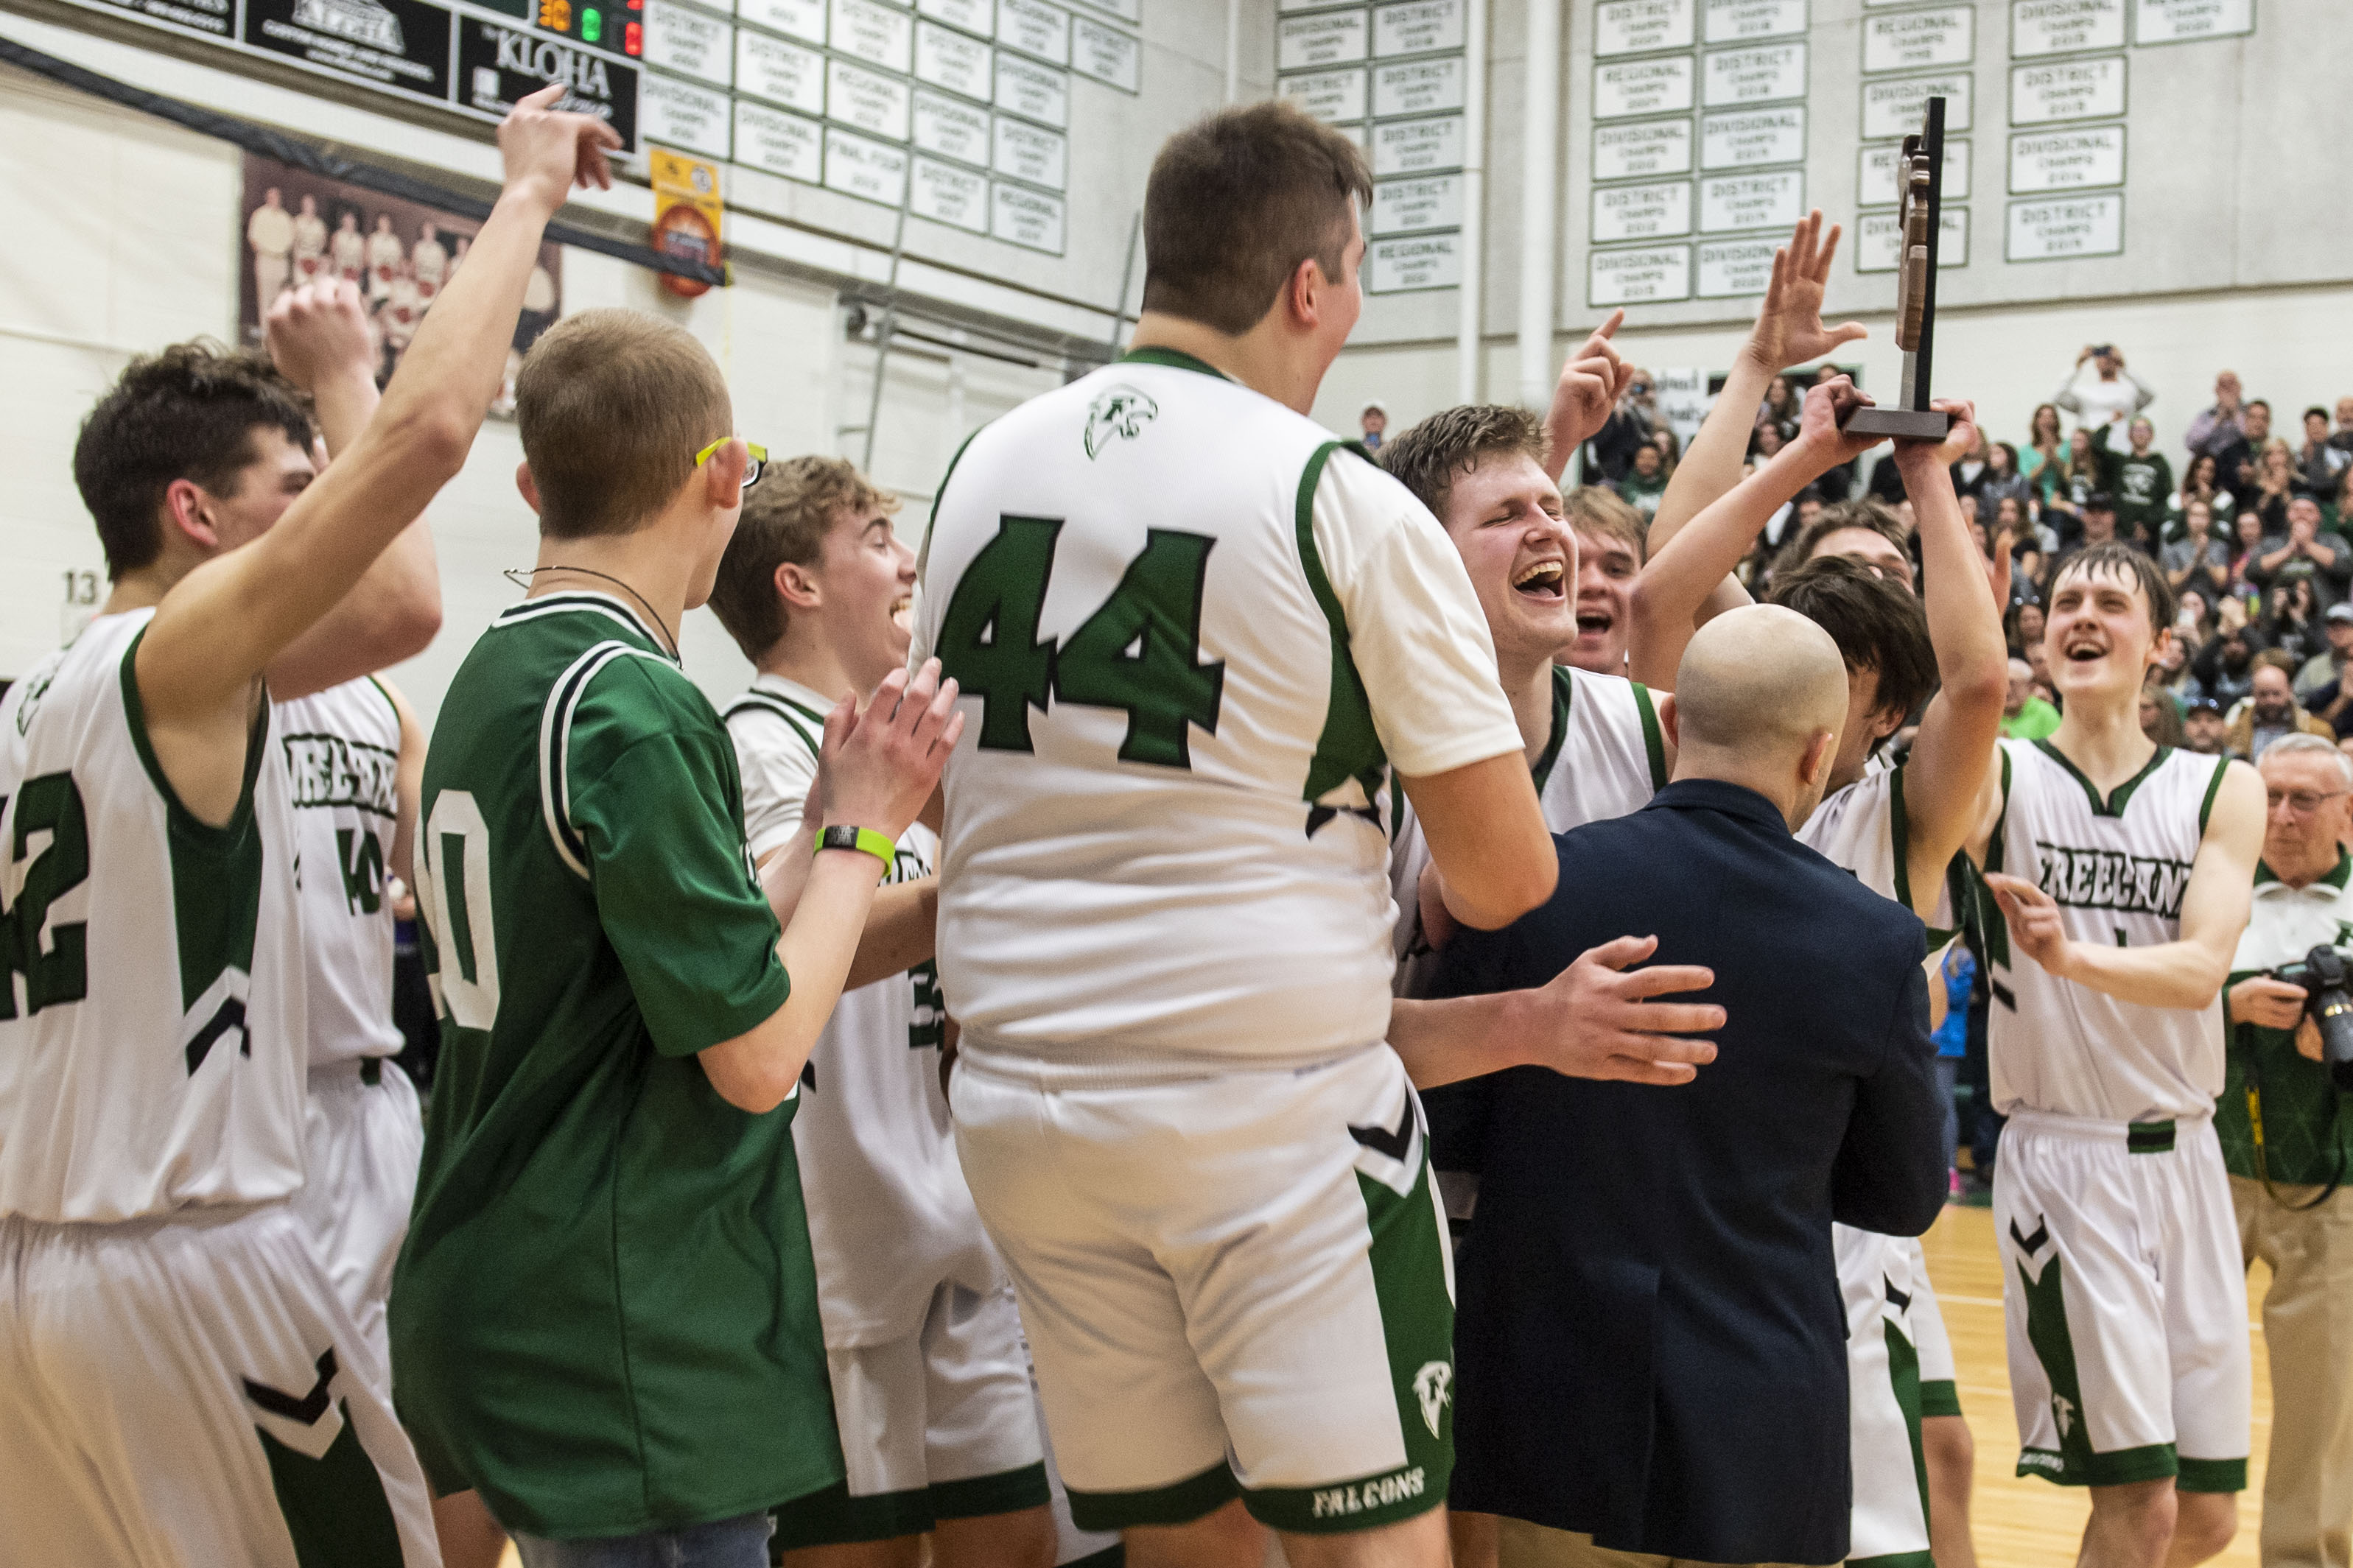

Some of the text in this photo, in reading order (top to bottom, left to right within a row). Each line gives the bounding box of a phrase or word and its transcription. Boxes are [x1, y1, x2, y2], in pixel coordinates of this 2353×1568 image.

[1384, 1, 1453, 24] DISTRICT
[1608, 1, 1680, 21] DISTRICT
[2021, 1, 2112, 20] DIVISIONAL
[1284, 17, 1360, 37] DIVISIONAL
[1876, 17, 1958, 33] REGIONAL
[497, 29, 613, 99] KLOHA
[1716, 51, 1791, 71] DISTRICT
[1384, 63, 1453, 84] DISTRICT
[1605, 66, 1681, 82] REGIONAL
[2025, 64, 2108, 88] DISTRICT
[1288, 74, 1353, 94] DISTRICT
[1871, 82, 1960, 102] DIVISIONAL
[1382, 122, 1452, 143] DISTRICT
[1706, 115, 1797, 135] DIVISIONAL
[1600, 127, 1683, 146] DIVISIONAL
[2017, 137, 2113, 155] DIVISIONAL
[1381, 180, 1450, 201] DISTRICT
[1605, 188, 1677, 207] DISTRICT
[1712, 179, 1788, 197] DISTRICT
[2021, 203, 2105, 224] DISTRICT
[1379, 241, 1453, 259] REGIONAL
[1597, 253, 1681, 270] DIVISIONAL
[63, 571, 98, 604] 13
[935, 513, 1225, 772] 44
[1312, 1466, 1425, 1518] FALCONS
